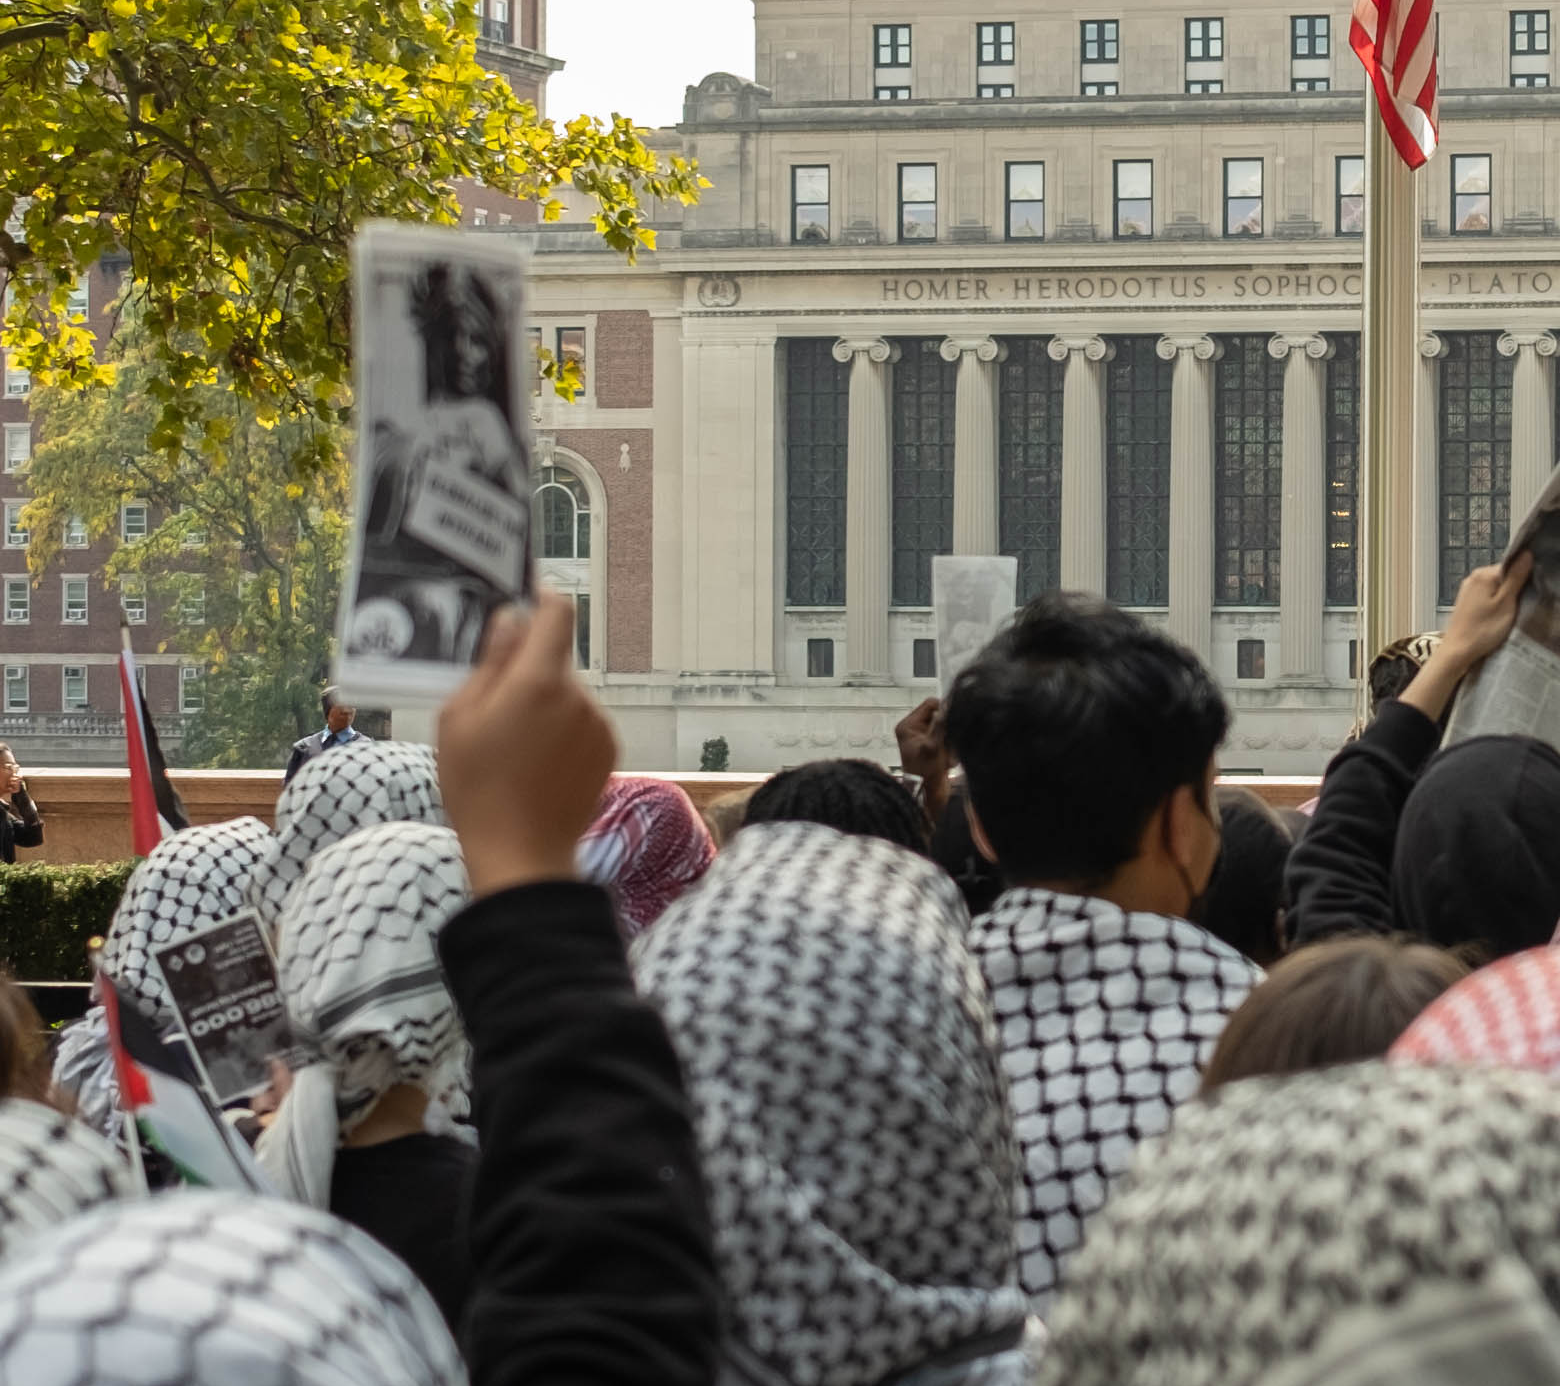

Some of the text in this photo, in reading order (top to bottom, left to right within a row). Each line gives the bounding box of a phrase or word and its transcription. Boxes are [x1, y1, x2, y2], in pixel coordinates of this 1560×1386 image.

[882, 277, 990, 303] HOMER
[1013, 274, 1207, 301] HERODOTUS
[1233, 271, 1362, 299] SOPHOC
[1447, 271, 1554, 295] PLATO
